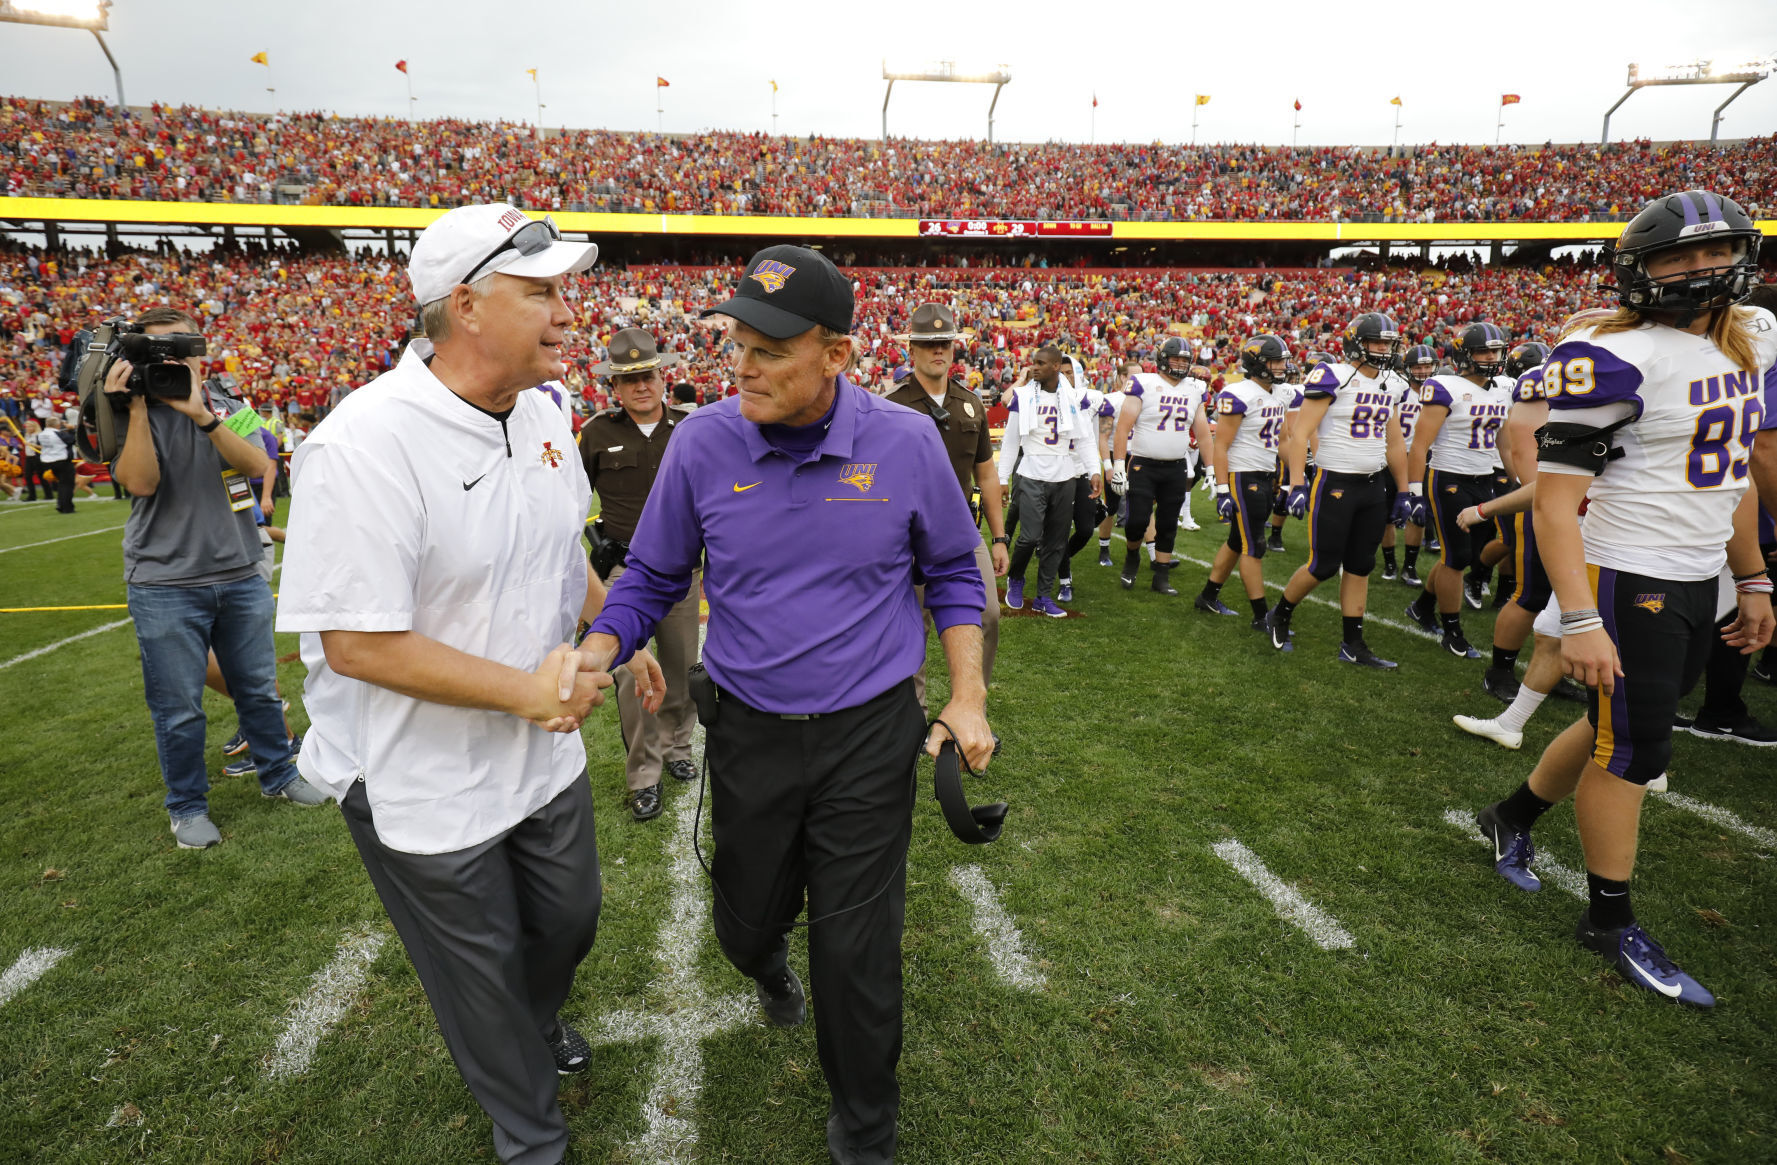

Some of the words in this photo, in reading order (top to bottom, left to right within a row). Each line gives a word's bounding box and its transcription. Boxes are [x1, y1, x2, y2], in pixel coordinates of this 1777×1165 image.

[928, 222, 942, 233] 26
[1011, 223, 1024, 233] 29
[1693, 222, 1716, 233] UNI
[753, 259, 797, 279] UNI
[1543, 356, 1596, 398] 89
[1686, 366, 1760, 407] UNI
[1160, 395, 1189, 406] UNI
[1355, 392, 1392, 406] UNI
[1038, 405, 1058, 415] UN
[1261, 406, 1284, 418] UNI
[1401, 403, 1424, 414] UN
[1470, 404, 1506, 417] UNI
[1157, 405, 1189, 432] 72
[1350, 405, 1391, 439] 88
[1044, 416, 1059, 446] 3
[1259, 418, 1284, 449] 45
[1468, 417, 1501, 450] 18
[1685, 394, 1764, 490] 89
[839, 463, 878, 481] UNI
[1634, 593, 1666, 604] UNI
